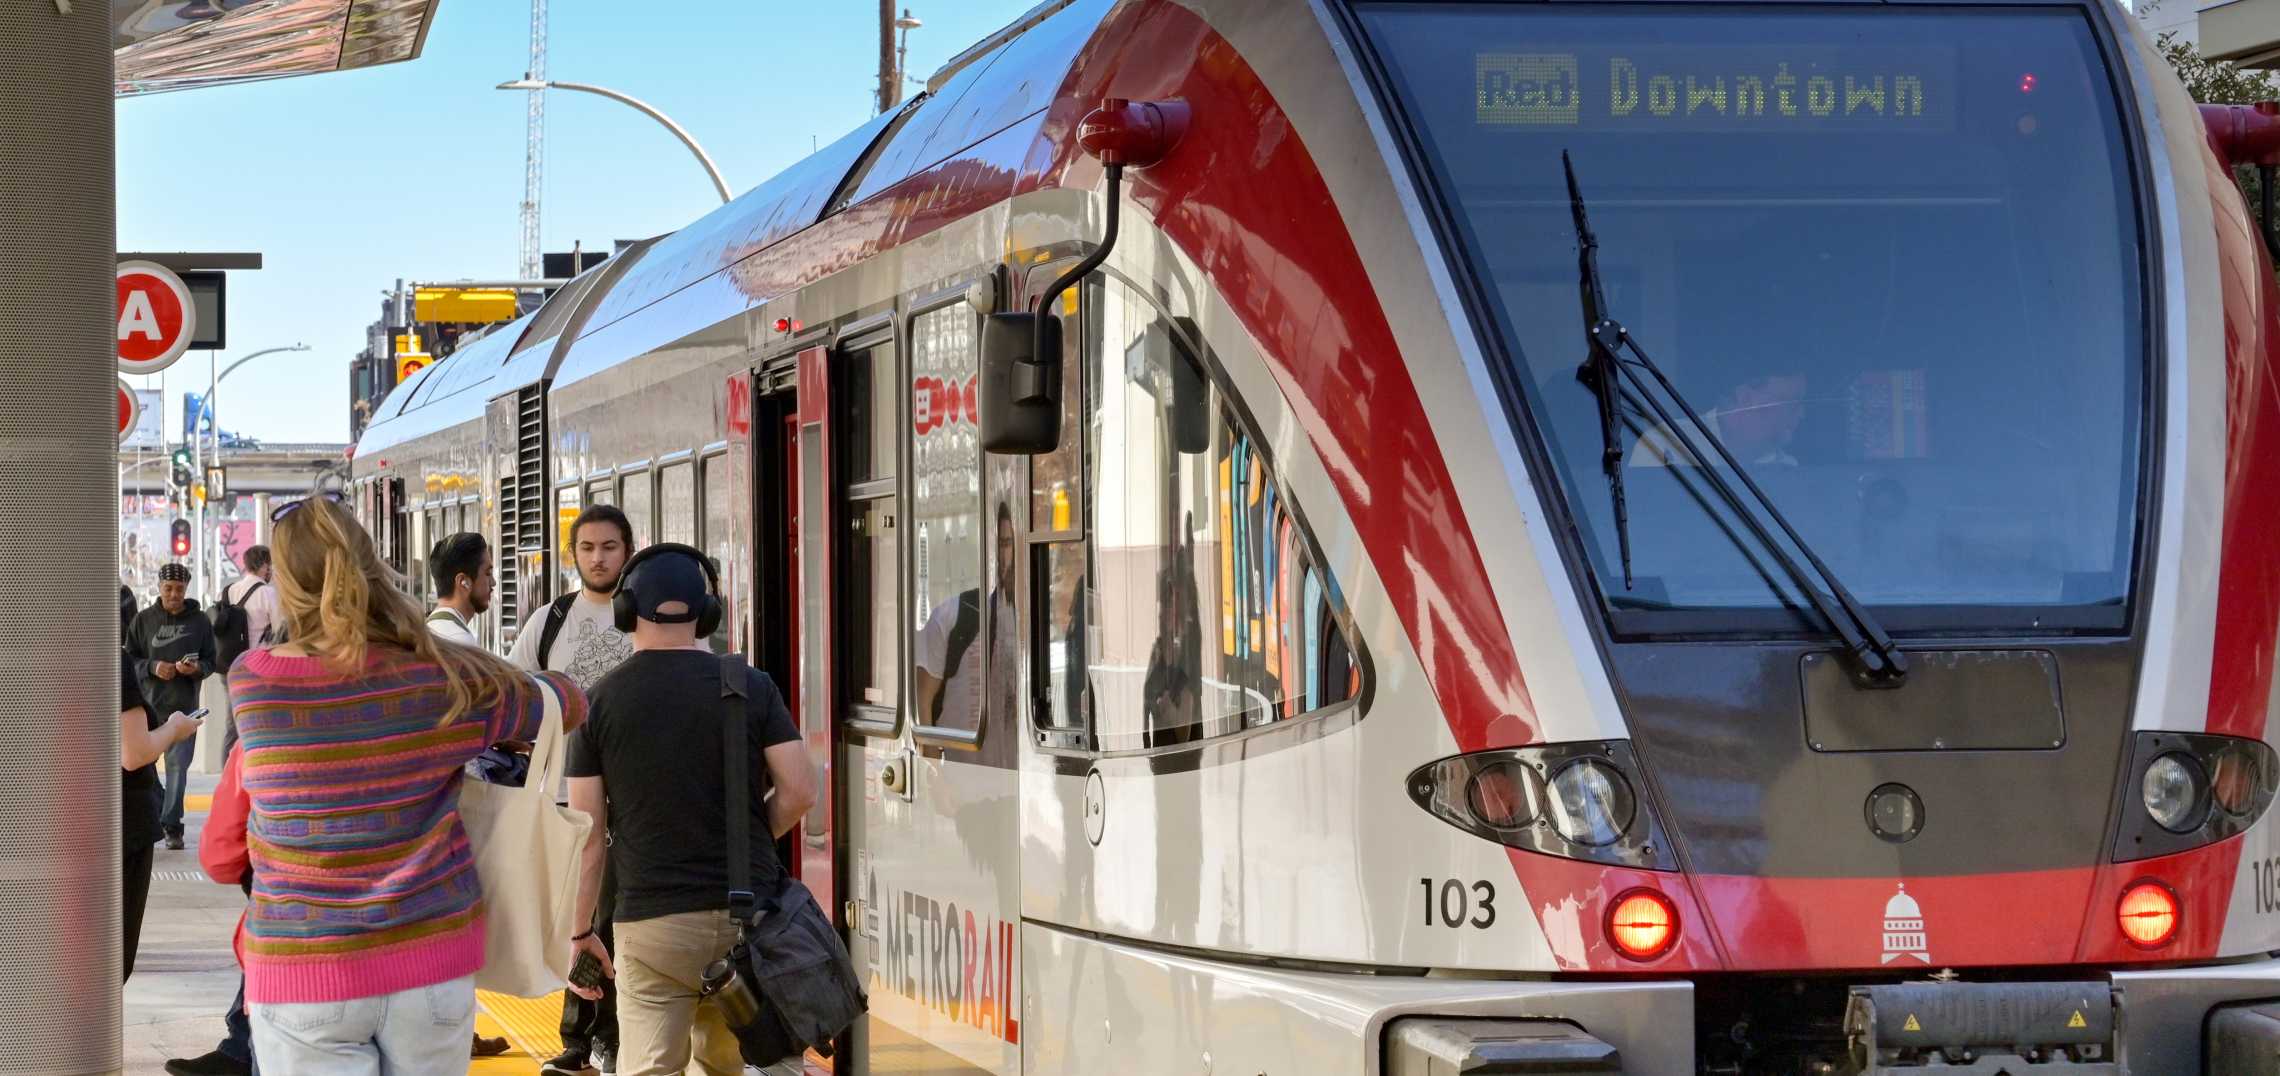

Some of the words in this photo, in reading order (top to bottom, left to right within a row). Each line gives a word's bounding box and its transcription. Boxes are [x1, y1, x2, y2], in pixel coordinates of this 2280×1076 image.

[1483, 70, 1570, 109] Red
[1610, 57, 1923, 116] Downtown
[117, 290, 163, 340] A
[1421, 878, 1496, 930] 103
[886, 882, 1019, 1046] METRORAIL
